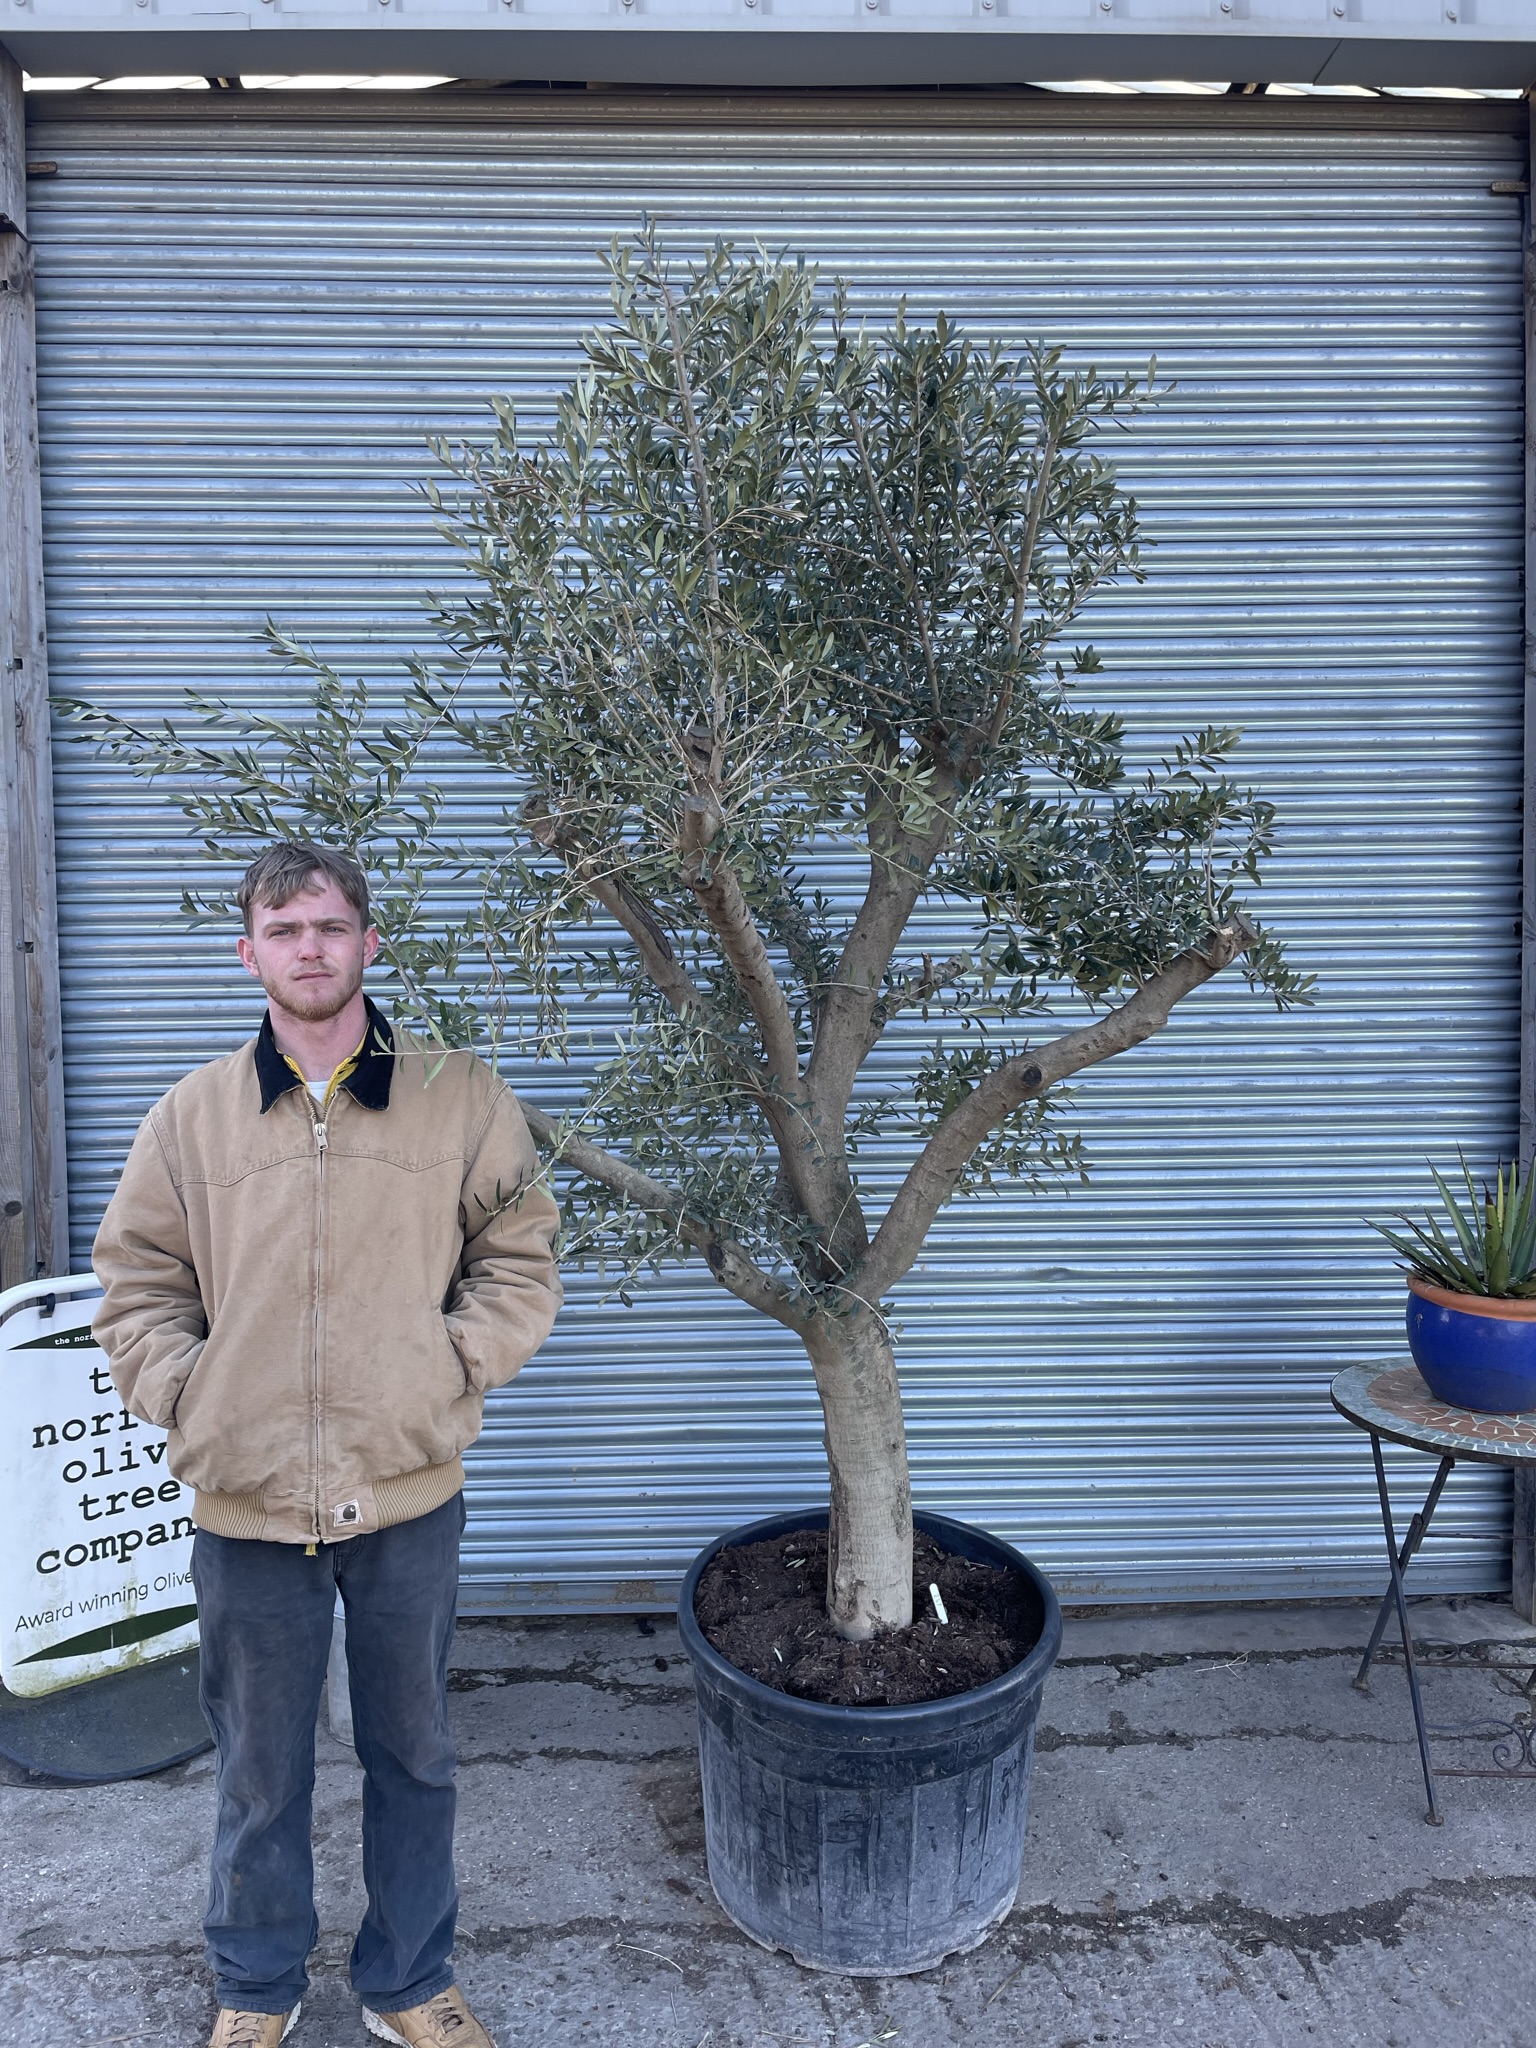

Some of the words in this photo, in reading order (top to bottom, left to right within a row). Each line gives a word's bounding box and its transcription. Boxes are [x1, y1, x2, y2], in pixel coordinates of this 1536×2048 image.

[55, 1337, 70, 1346] the
[78, 1480, 181, 1521] tree
[14, 1601, 73, 1633] Award
[78, 1583, 149, 1614] winning
